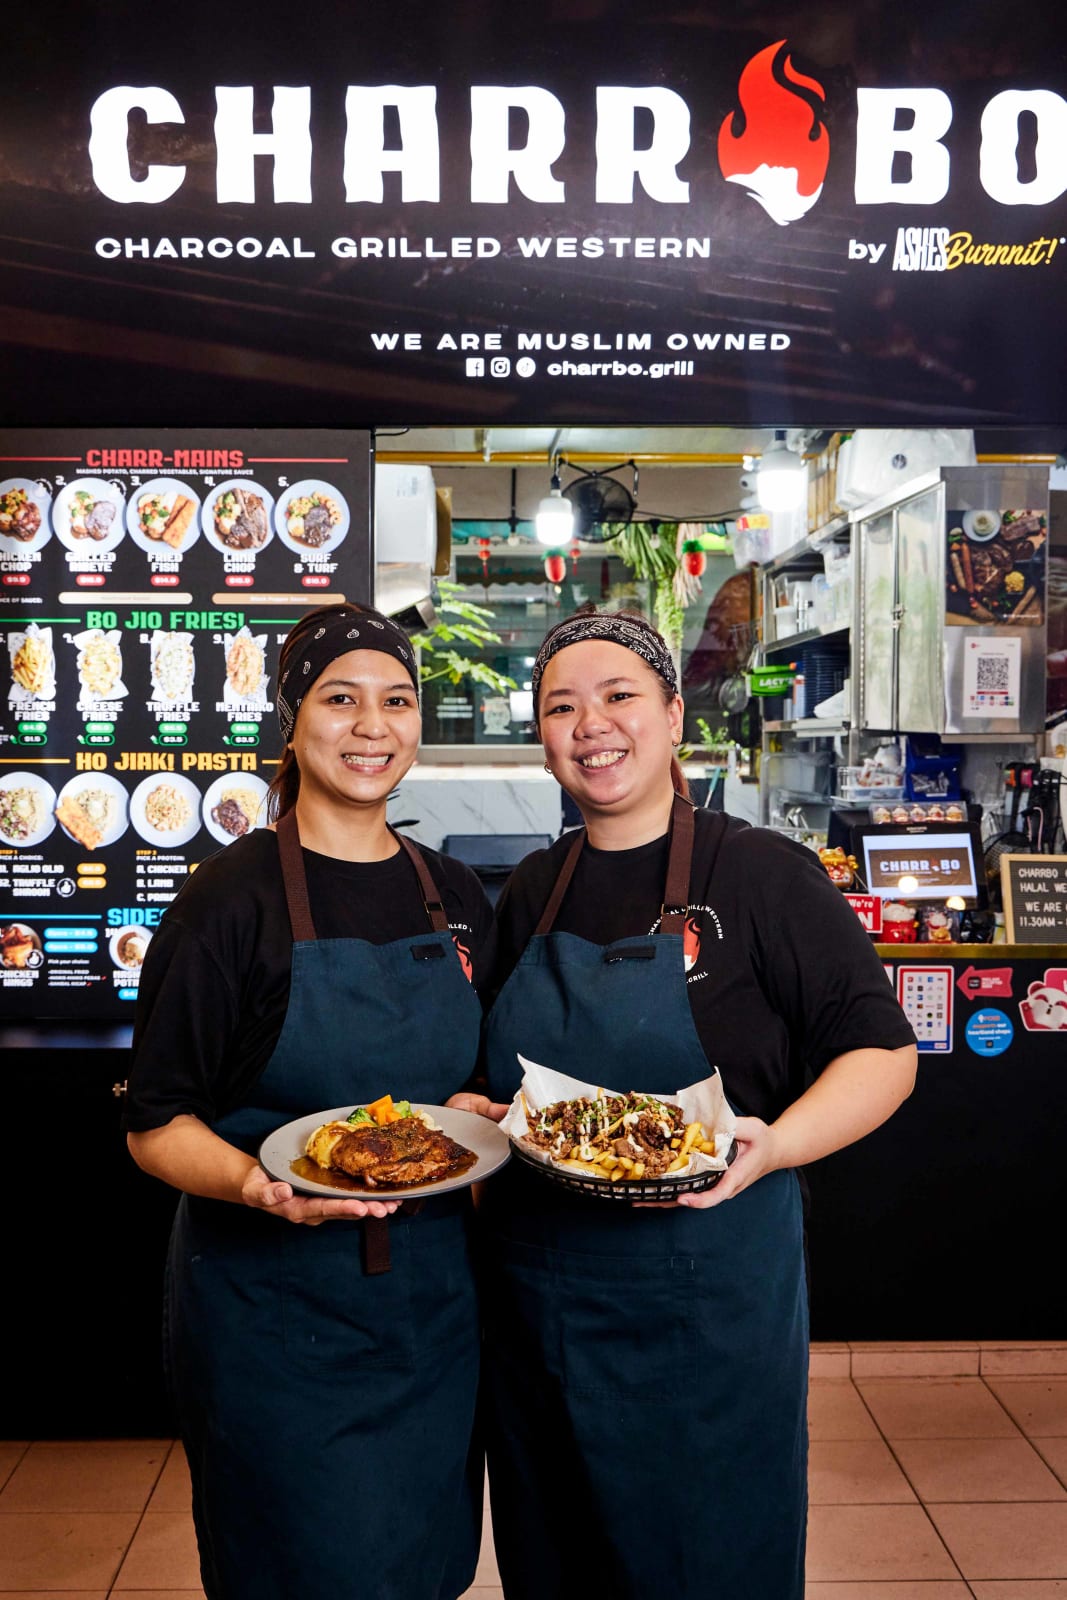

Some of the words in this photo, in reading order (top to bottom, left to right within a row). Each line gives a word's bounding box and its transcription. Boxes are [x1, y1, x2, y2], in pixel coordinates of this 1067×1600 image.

[89, 85, 691, 204] CHARR
[95, 237, 316, 259] CHARCOAL
[331, 237, 502, 259] GRILLED
[517, 237, 711, 259] WESTERN
[848, 239, 887, 264] by
[892, 227, 950, 271] ASHES
[946, 231, 1058, 270] Burnnit!
[371, 333, 422, 350] WE
[436, 333, 502, 350] ARE
[517, 333, 652, 350] MUSLIM
[666, 333, 791, 350] OWNED
[547, 360, 694, 378] charrbo.grill
[86, 449, 244, 468] CHARR-MAINS
[147, 551, 183, 562] FRIED
[300, 553, 332, 563] SURF
[0, 561, 32, 571] CHOP
[151, 562, 179, 572] FISH
[223, 562, 256, 573] CHOP
[307, 563, 338, 573] TURF
[86, 611, 117, 630] BO
[125, 611, 162, 630] JIO
[170, 611, 245, 630] FRIES!
[8, 701, 56, 712] FRENCH
[76, 701, 124, 712] CHEESE
[146, 702, 200, 712] TRUFFLE
[15, 711, 50, 721] FRIES
[82, 711, 118, 721] FRIES
[155, 711, 191, 722] FRIES
[227, 712, 262, 722] FRIES
[76, 752, 107, 771] HO
[114, 752, 175, 771] JIAK!
[182, 752, 257, 771] PASTA
[147, 864, 188, 874] CHICKEN
[880, 860, 930, 872] CHARR
[940, 859, 961, 871] BO
[1018, 867, 1058, 878] CHARRBO
[13, 878, 56, 888] TRUFFLE
[1020, 881, 1049, 893] HALAL
[1025, 901, 1040, 912] WE
[1043, 901, 1062, 913] ARE
[107, 908, 168, 927] SIDE
[1019, 916, 1056, 928] 11.30AM
